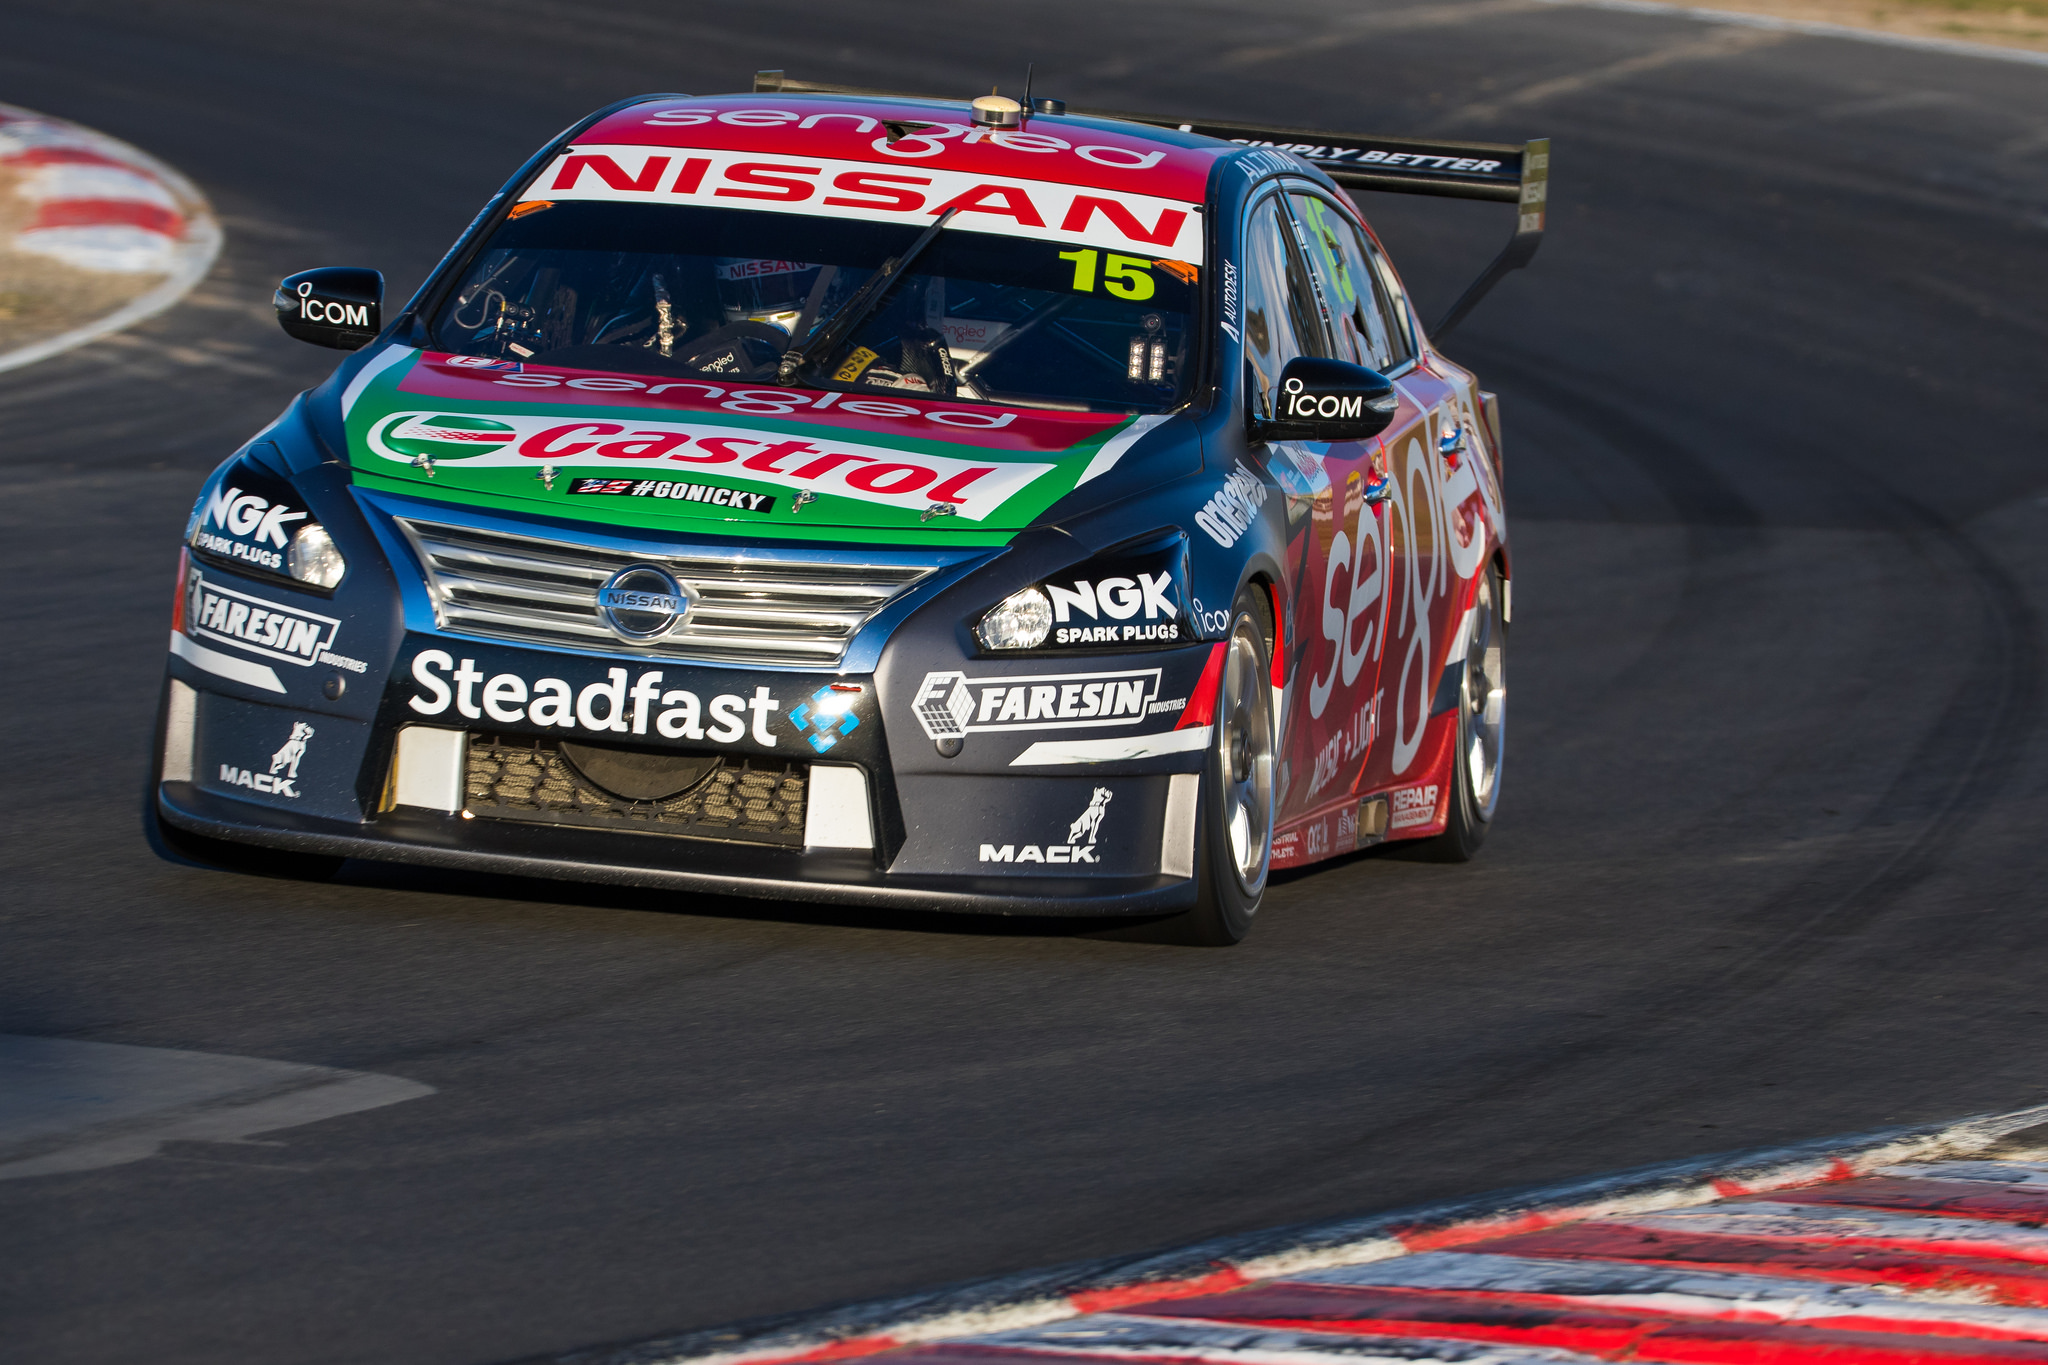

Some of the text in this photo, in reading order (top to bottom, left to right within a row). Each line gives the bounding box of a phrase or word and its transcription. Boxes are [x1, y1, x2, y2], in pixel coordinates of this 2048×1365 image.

[643, 108, 1167, 169] sengled
[1235, 150, 1303, 184] ALTIMA
[1356, 149, 1501, 173] BETTER
[551, 154, 1189, 248] NISSAN
[730, 260, 806, 279] NISSAN
[1059, 248, 1156, 301] 15
[1224, 258, 1238, 325] AUTODESK
[941, 324, 986, 343] engled
[699, 352, 734, 372] engled
[492, 373, 1018, 429] sengled
[519, 423, 998, 505] Castrol
[631, 480, 766, 511] #GONICKY
[202, 484, 307, 549] NGK
[197, 531, 282, 569] SPARK PLUGS
[607, 592, 678, 610] NISSAN
[1045, 570, 1178, 623] NGK
[200, 592, 321, 657] FARESIN
[1056, 624, 1179, 645] SPARK PLUGS
[318, 650, 368, 674] INDUSTRIES
[408, 649, 780, 747] Steadfast
[976, 680, 1145, 723] FARESIN
[1148, 697, 1186, 714] INDUSTRIES
[219, 763, 297, 798] MACK
[1393, 784, 1438, 812] REPAIR
[979, 844, 1097, 863] MACK
[1270, 847, 1294, 859] THLETE
